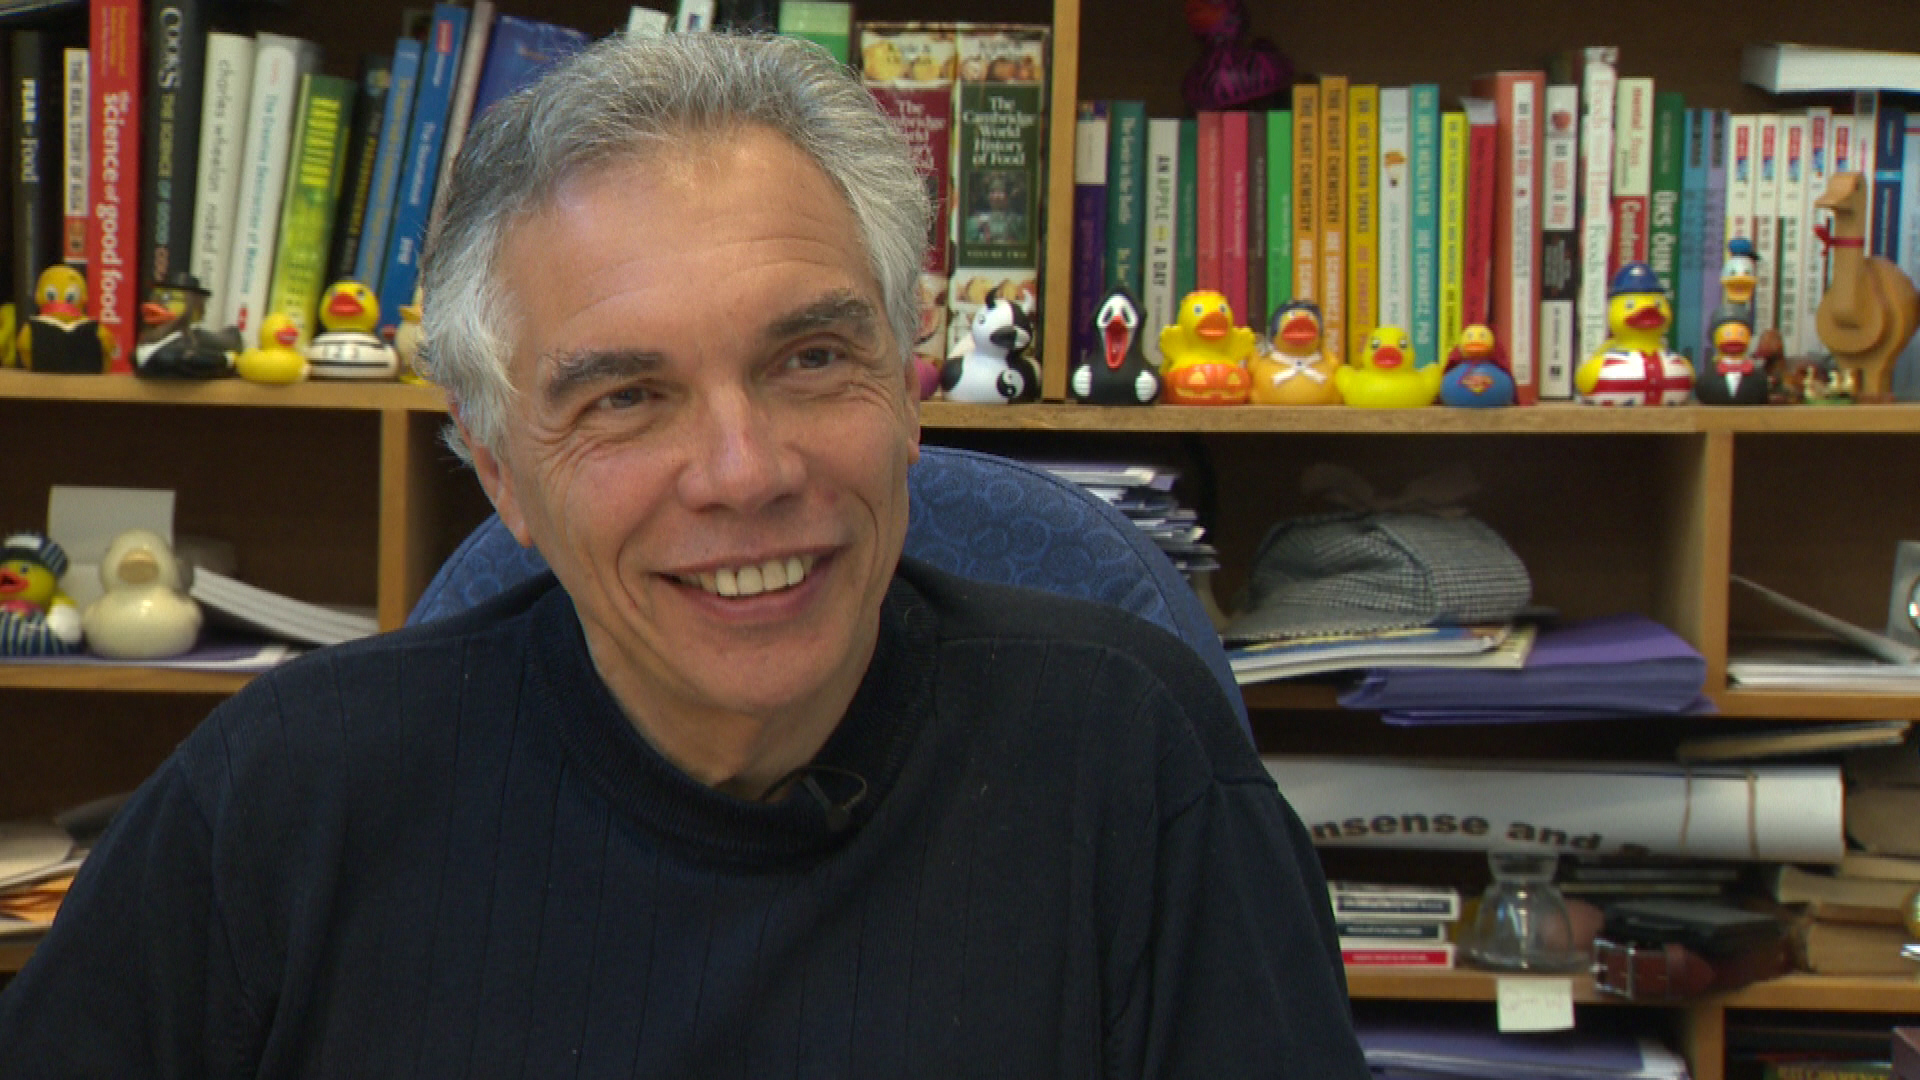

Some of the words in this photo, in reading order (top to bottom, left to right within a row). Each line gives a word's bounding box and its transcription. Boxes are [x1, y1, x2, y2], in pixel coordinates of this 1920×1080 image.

[102, 91, 124, 183] science
[1155, 155, 1171, 173] AN
[1154, 176, 1170, 220] APPLE
[97, 202, 122, 265] good
[1153, 246, 1167, 256] A
[1152, 258, 1167, 287] DAY
[100, 268, 122, 324] food
[1311, 812, 1490, 840] nsense
[1506, 820, 1603, 850] and
